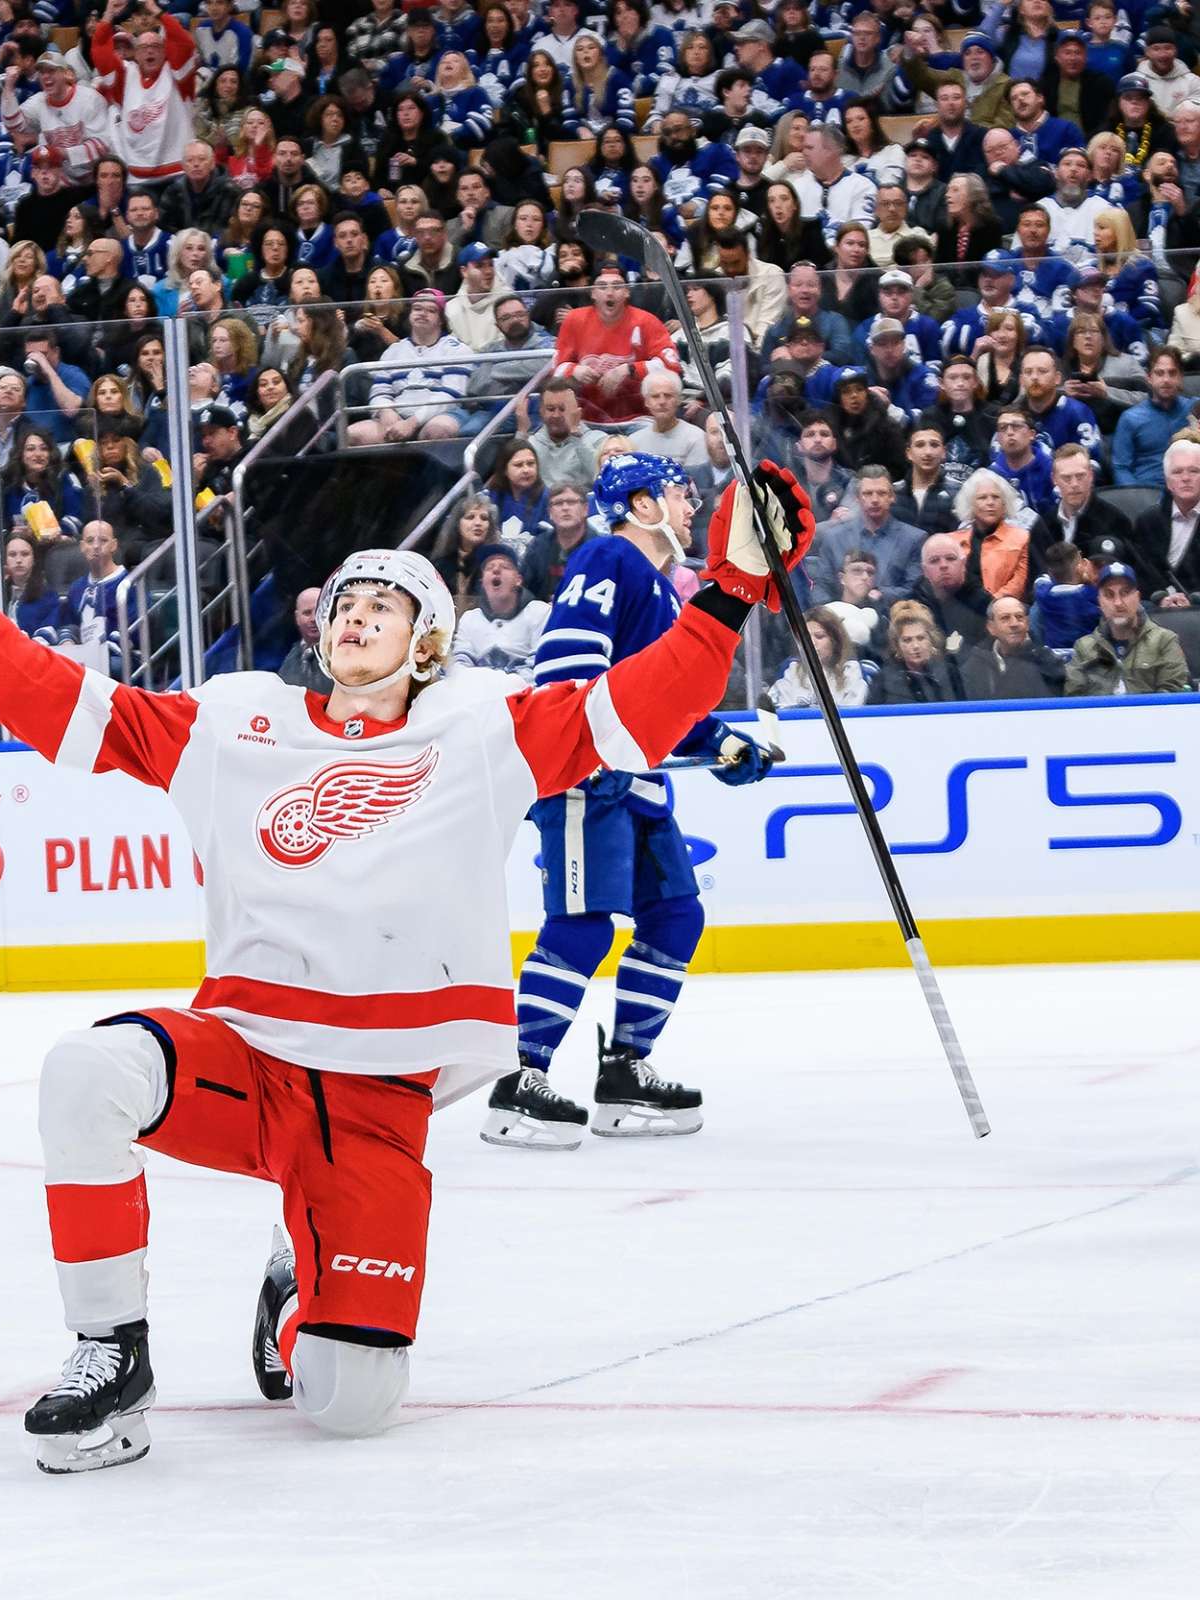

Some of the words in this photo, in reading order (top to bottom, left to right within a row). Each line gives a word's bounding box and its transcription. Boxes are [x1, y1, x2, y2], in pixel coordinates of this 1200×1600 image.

[557, 573, 616, 616] 44
[237, 733, 277, 747] PRIORITY
[766, 750, 1183, 859] PS5
[44, 833, 172, 893] PLAN
[330, 1253, 416, 1283] CCM
